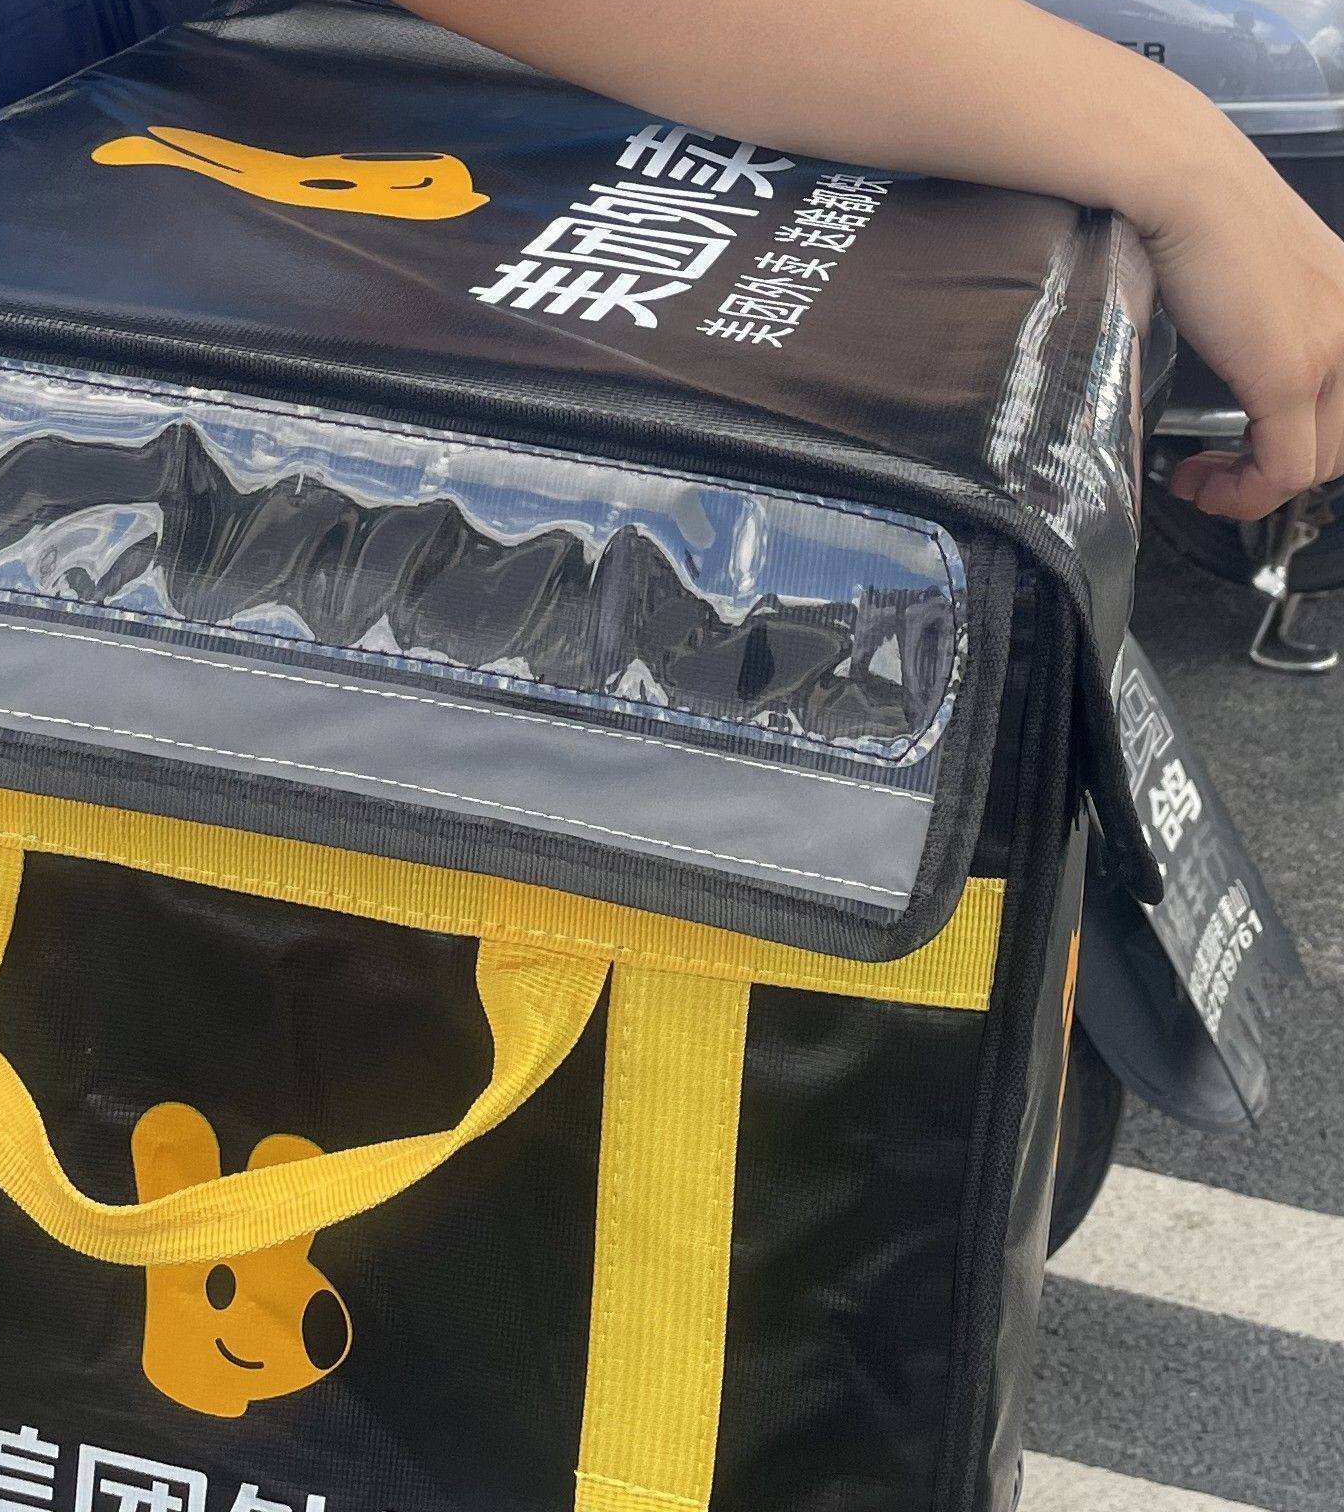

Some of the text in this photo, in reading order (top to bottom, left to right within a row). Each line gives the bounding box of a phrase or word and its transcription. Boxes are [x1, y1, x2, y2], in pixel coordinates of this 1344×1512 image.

[467, 123, 797, 329] 美团外卖
[696, 172, 894, 349] 美团外卖 送啥都快
